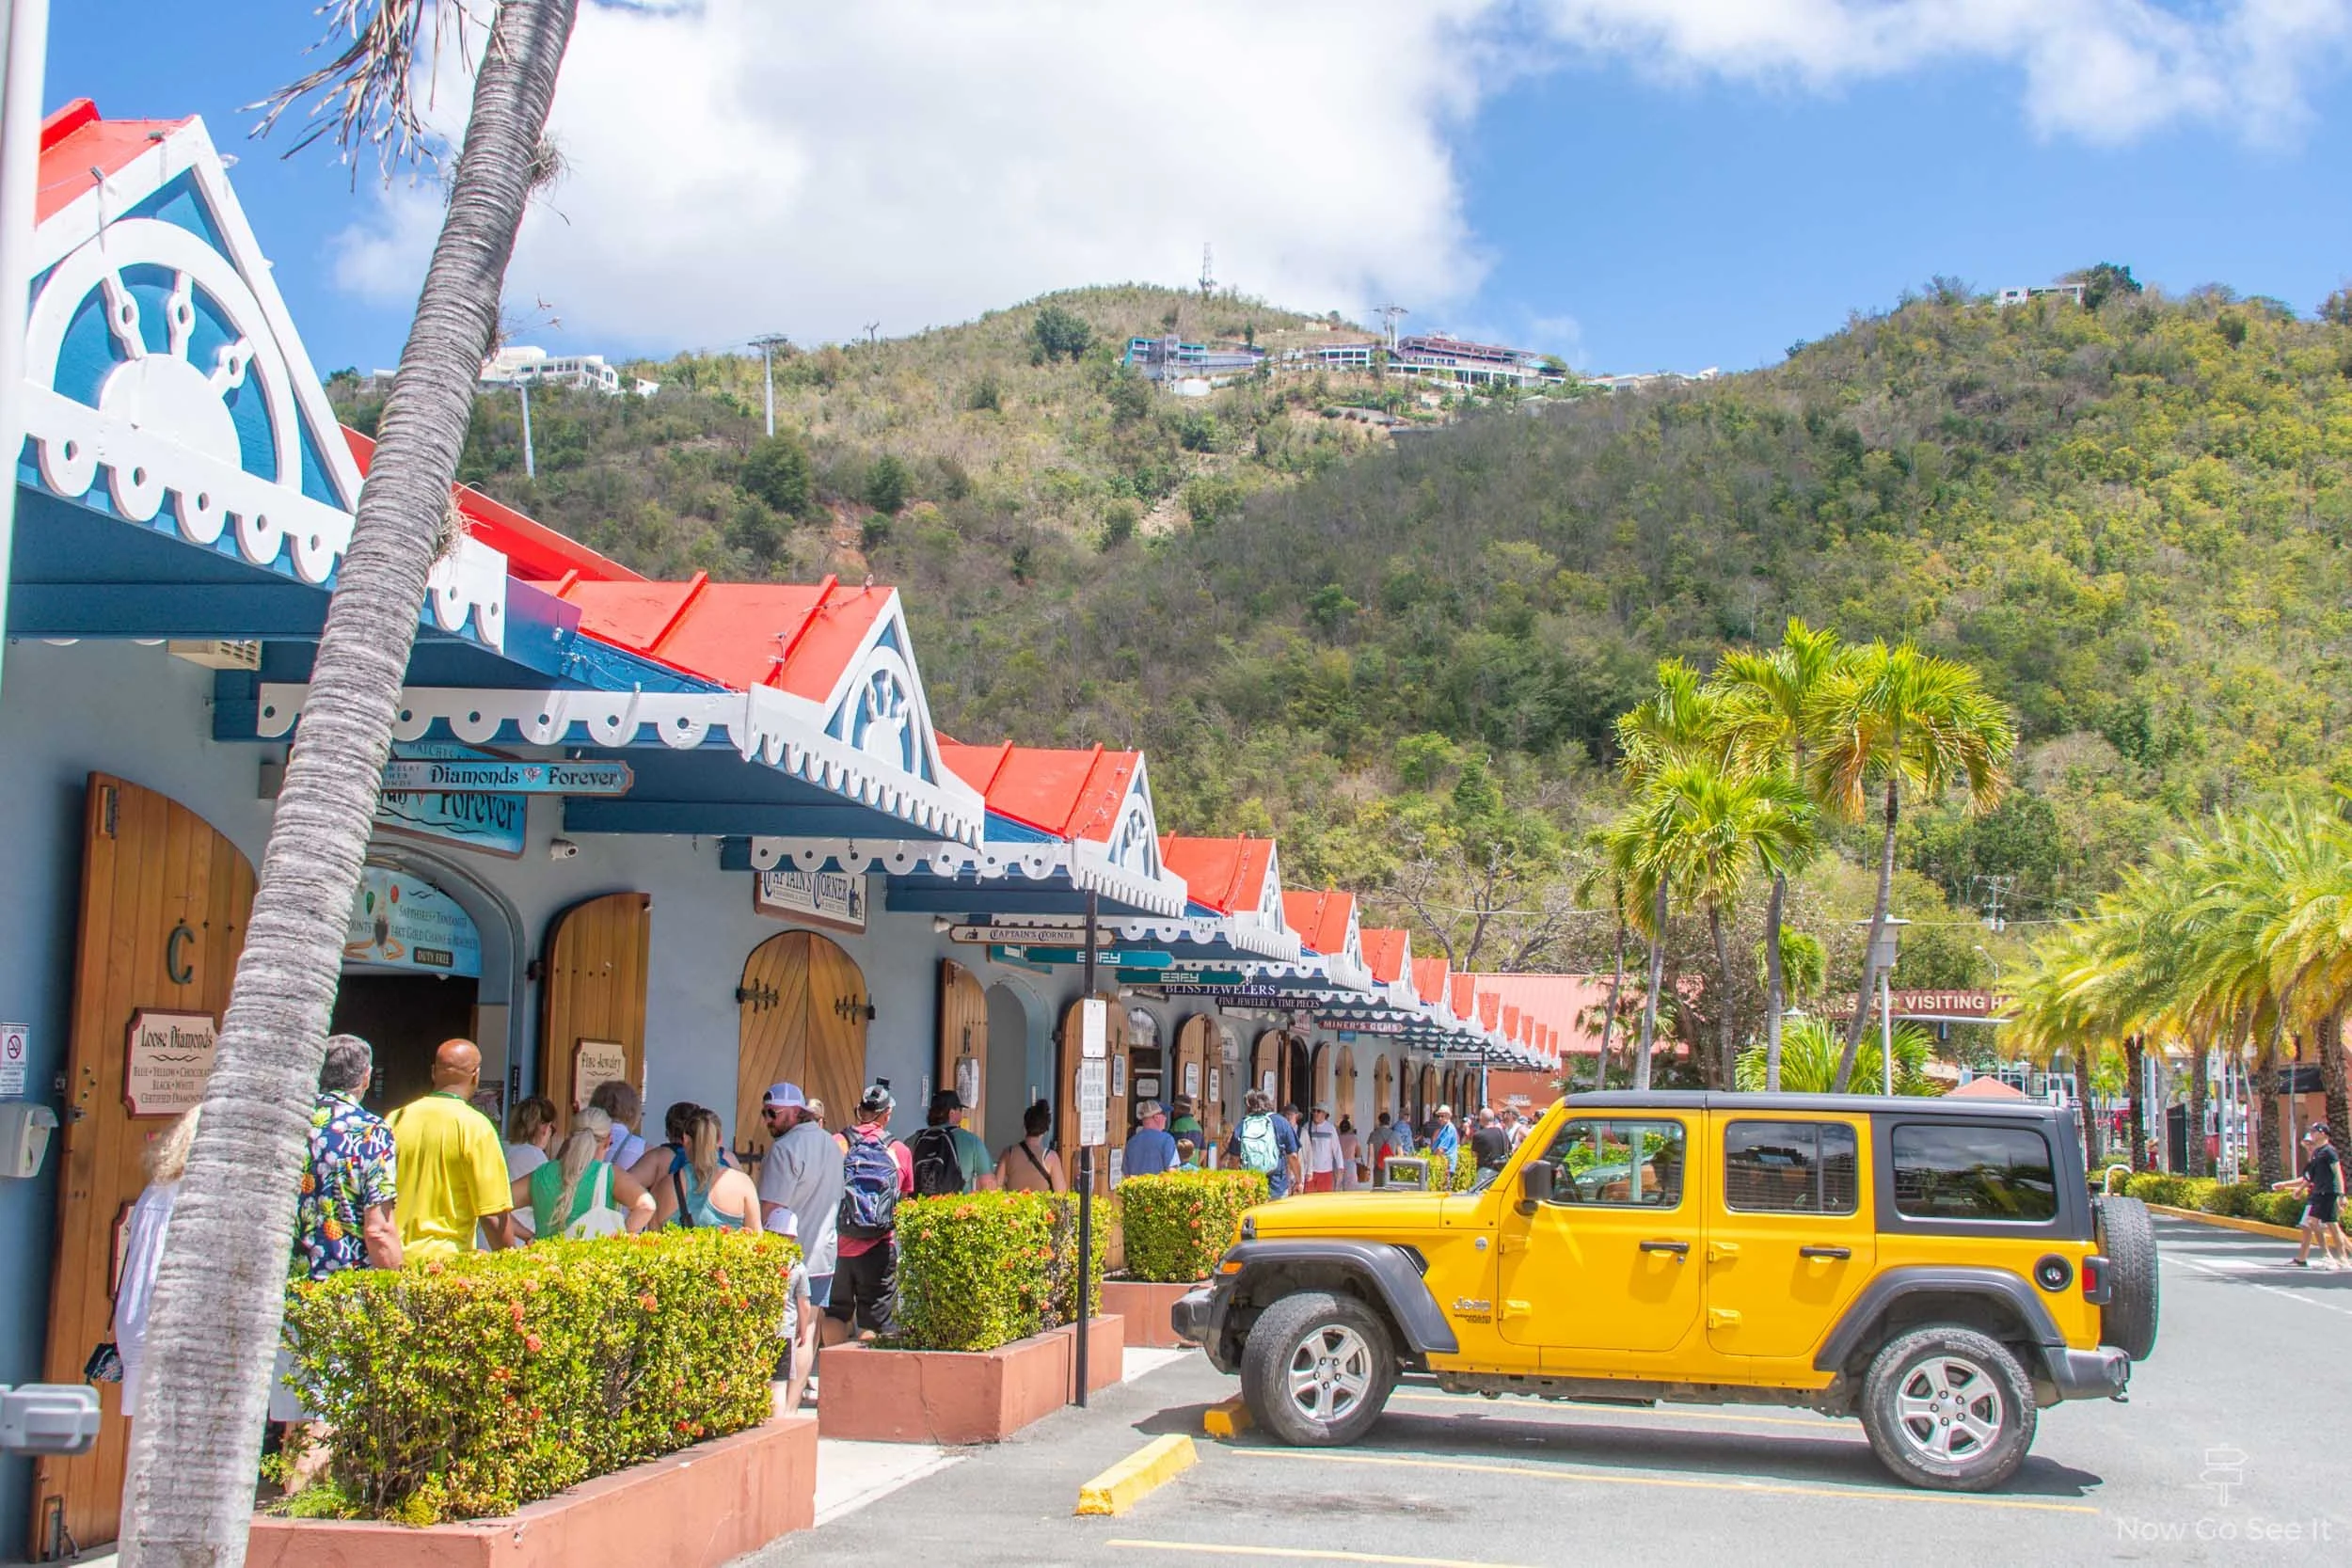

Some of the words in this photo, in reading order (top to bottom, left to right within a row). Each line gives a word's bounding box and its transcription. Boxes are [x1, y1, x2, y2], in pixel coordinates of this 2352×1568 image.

[431, 764, 519, 787] Diamonds
[548, 766, 618, 786] Forever
[814, 872, 847, 910] CORNER
[990, 928, 1037, 940] CAPTAIN'S
[1038, 930, 1074, 942] CORNER
[167, 926, 195, 984] C
[417, 949, 434, 961] DUTY
[436, 952, 450, 964] FREE
[1076, 951, 1120, 963] EFY
[1161, 973, 1200, 983] EFFY
[1166, 984, 1201, 994] BLISS
[1203, 984, 1276, 995] JEWELERS
[1219, 997, 1235, 1006] FINE
[1237, 997, 1267, 1006] JEWELRY
[1278, 998, 1296, 1008] TIME
[1297, 999, 1320, 1009] PIECES
[1905, 995, 1984, 1010] VISITING
[1369, 1022, 1398, 1033] GEMS
[141, 1024, 167, 1047] Loose
[170, 1025, 214, 1052] Diamonds
[1452, 1295, 1491, 1311] Jeep
